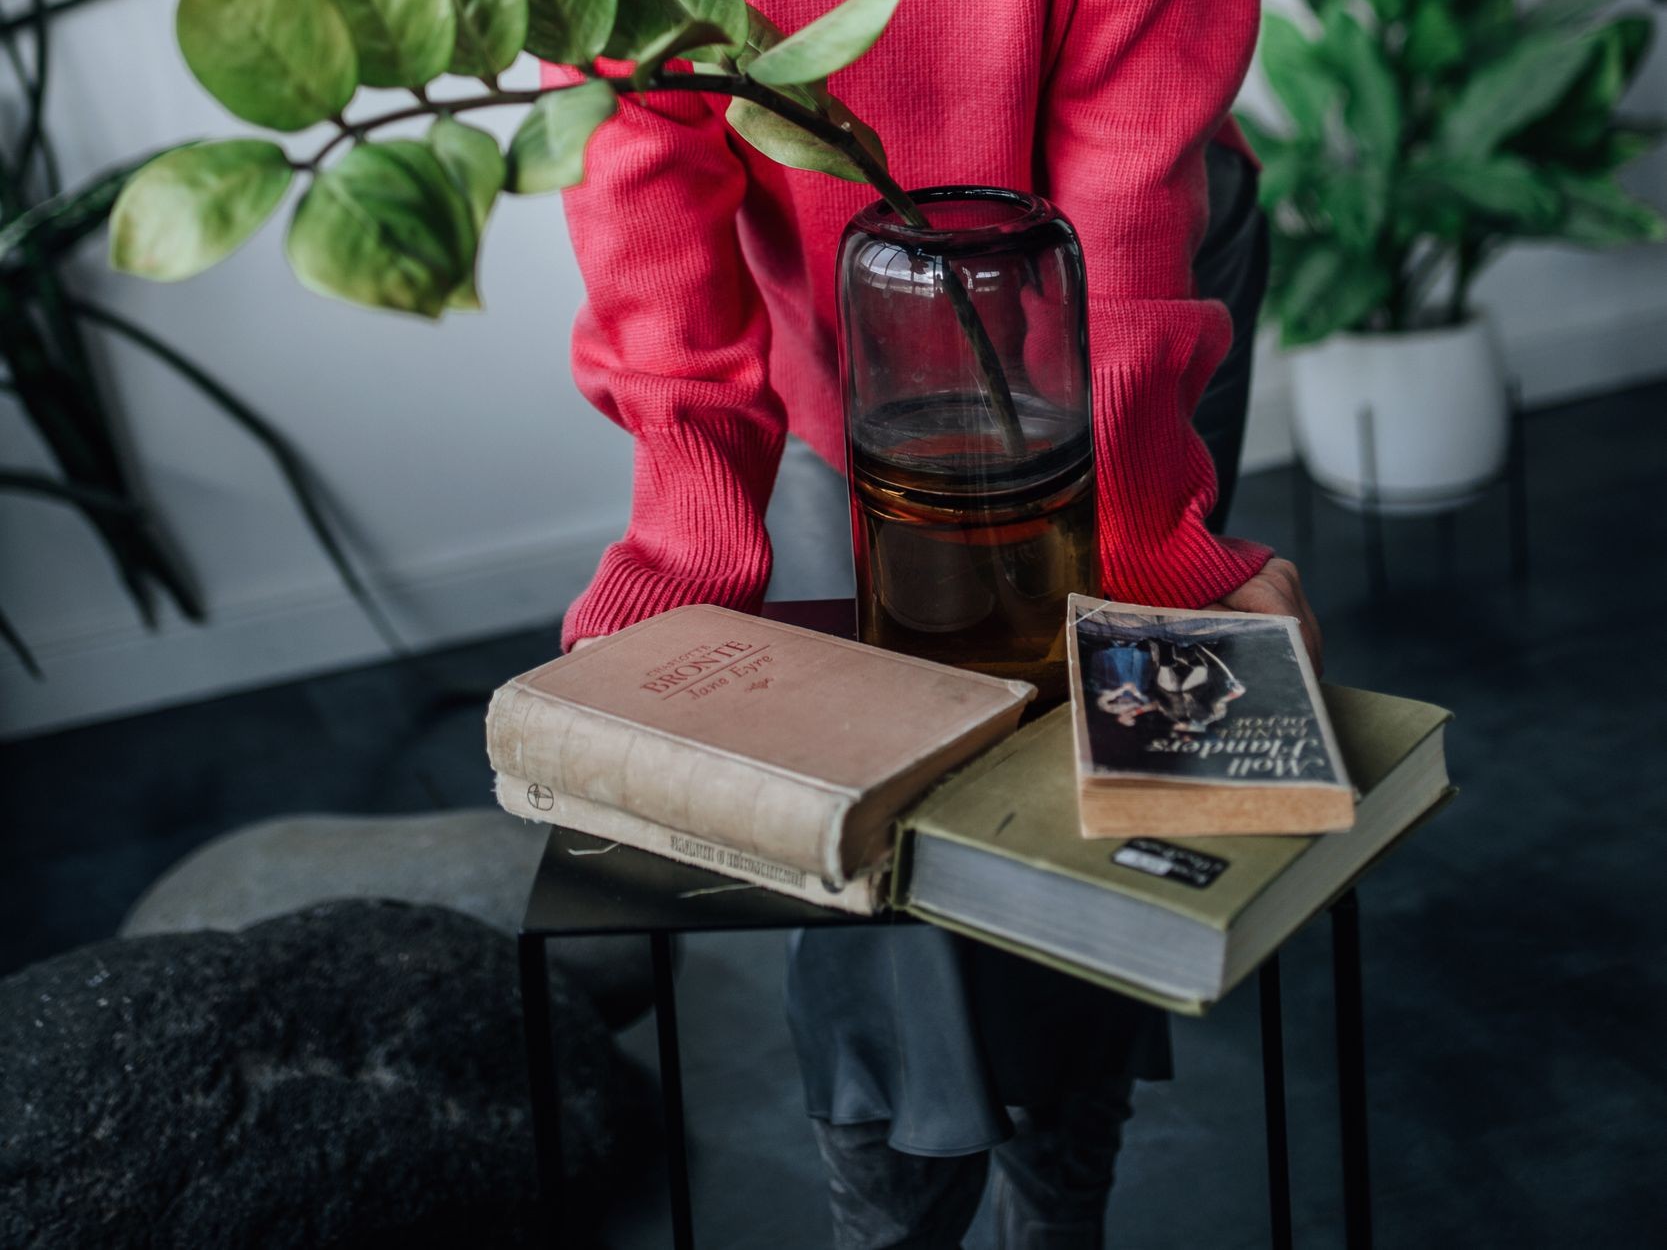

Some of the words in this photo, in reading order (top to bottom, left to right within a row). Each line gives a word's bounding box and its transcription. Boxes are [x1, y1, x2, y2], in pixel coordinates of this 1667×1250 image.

[687, 677, 730, 701] Jane
[729, 654, 774, 678] Eyre
[1232, 717, 1309, 727] DEFOE
[1217, 727, 1309, 738] DANIEL
[1148, 738, 1318, 760] Flanders
[1227, 757, 1325, 777] Moll
